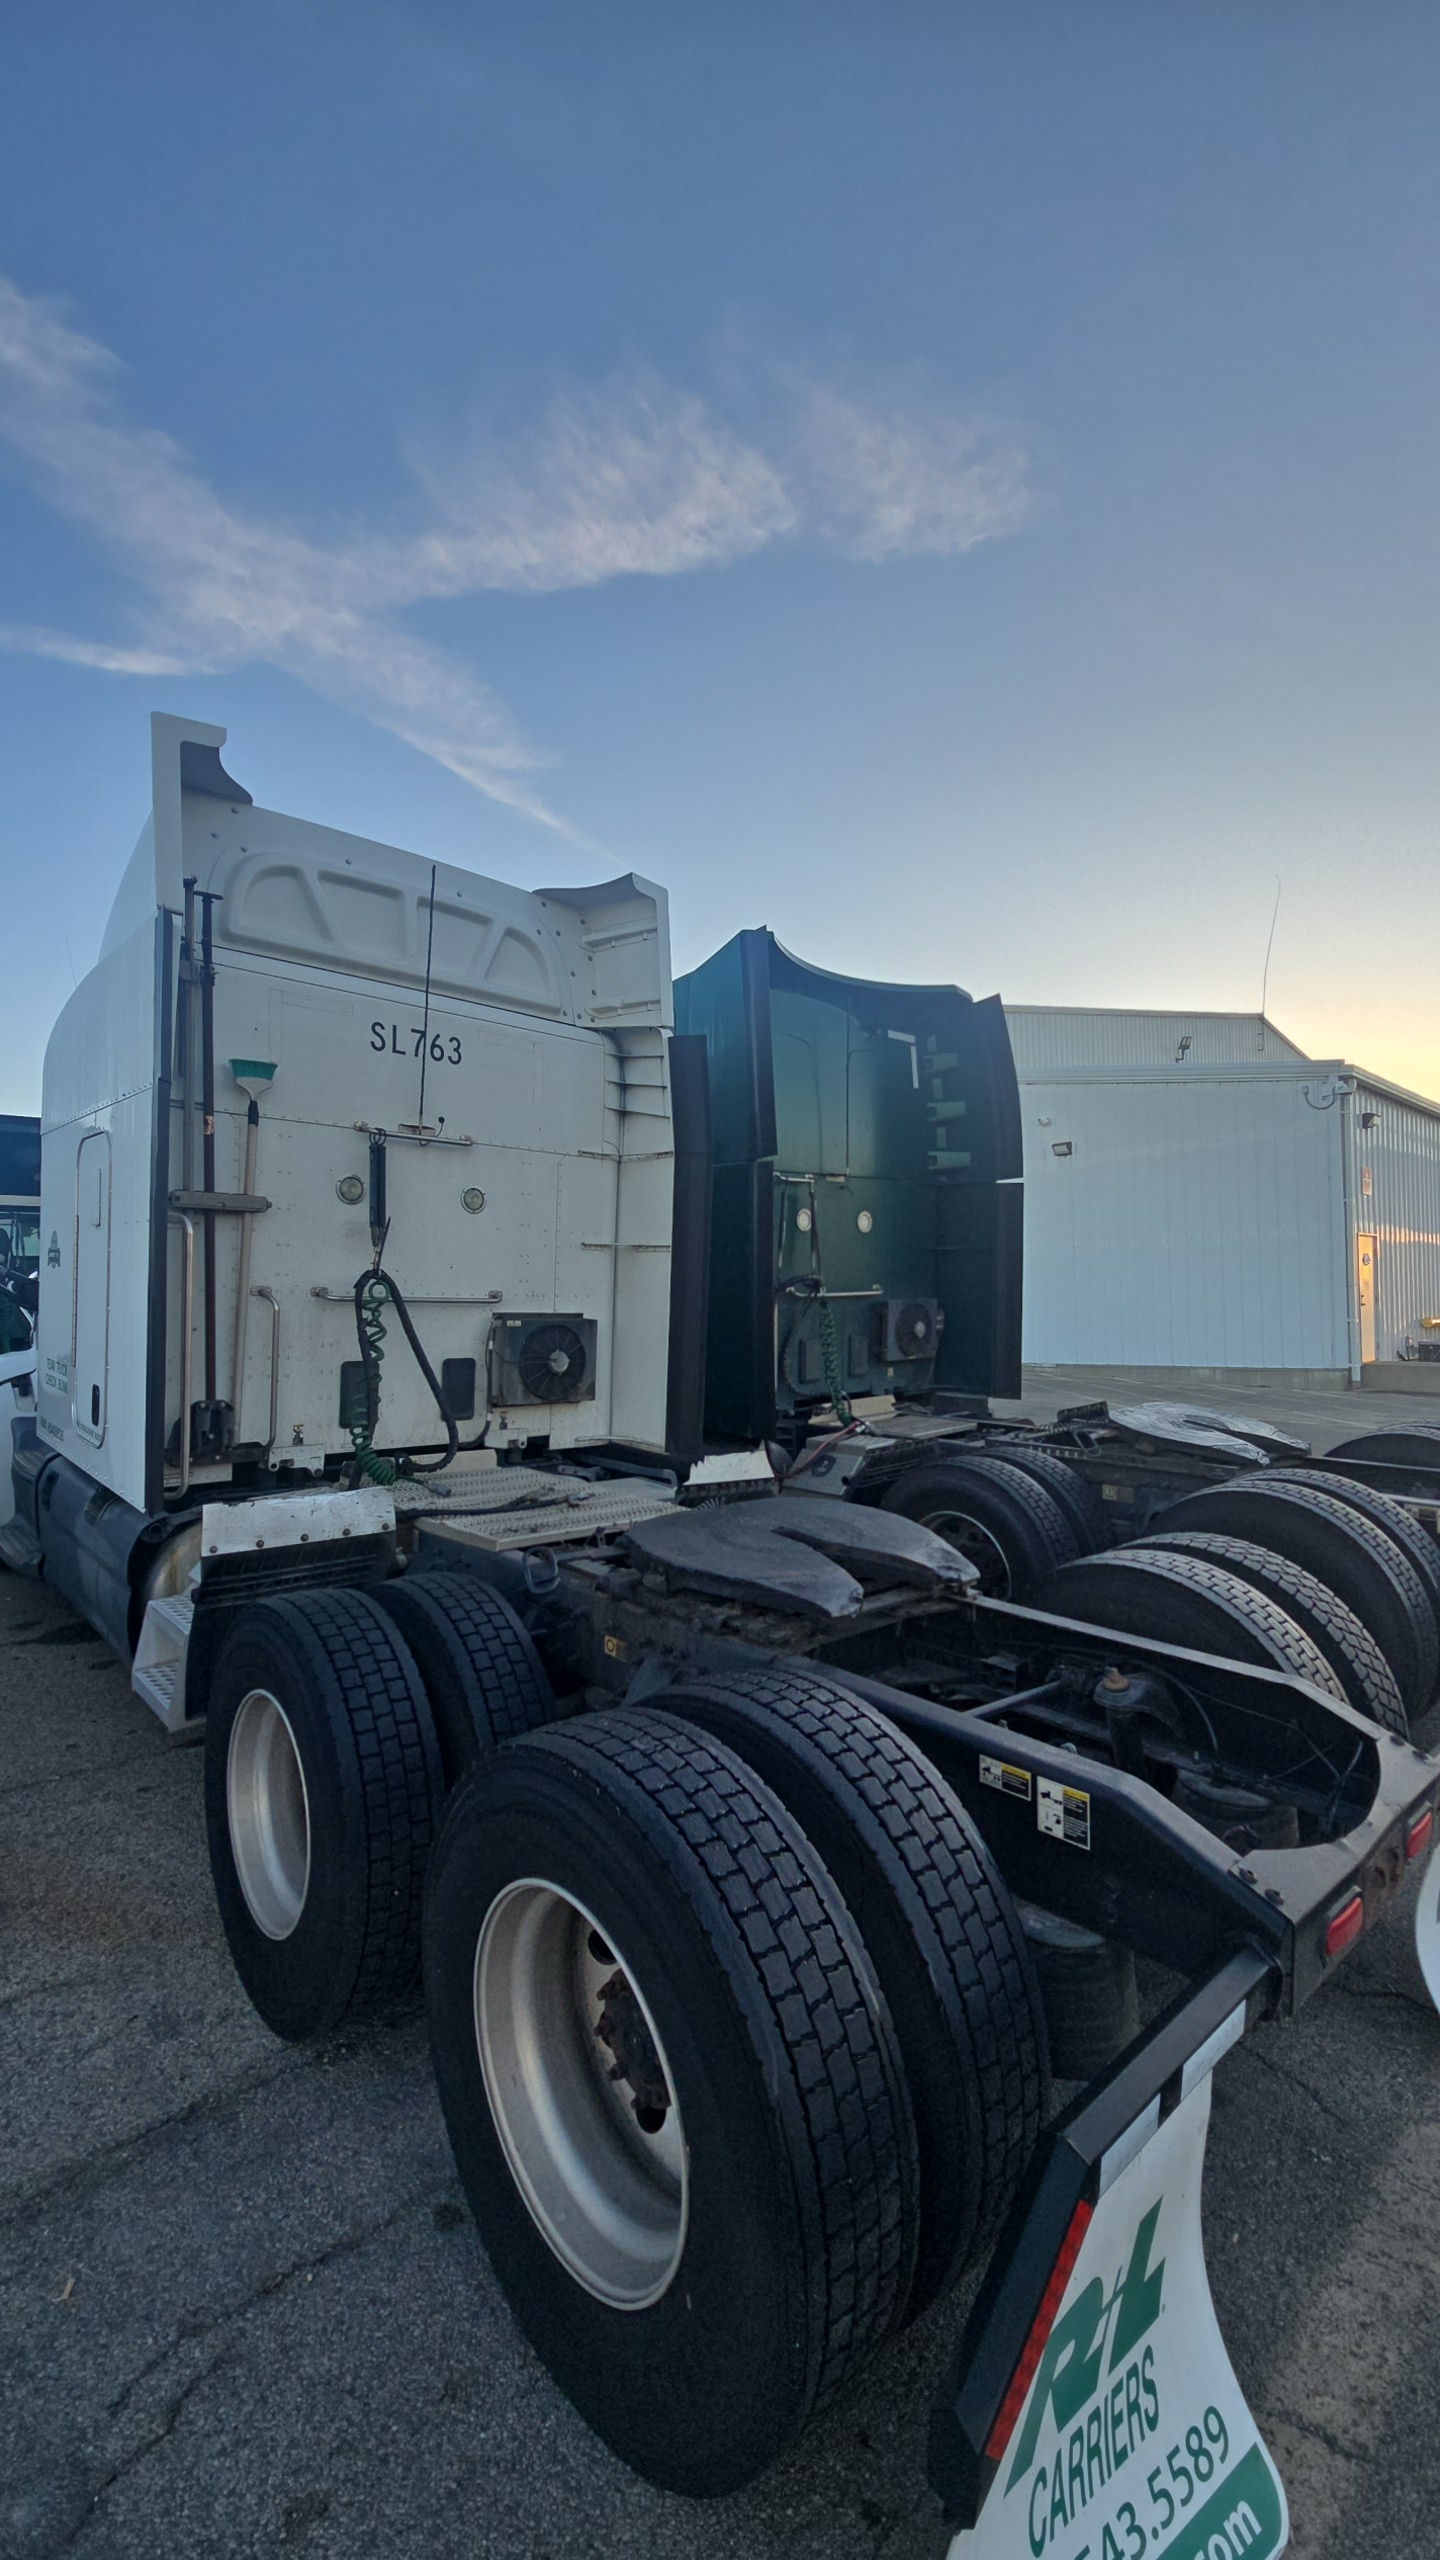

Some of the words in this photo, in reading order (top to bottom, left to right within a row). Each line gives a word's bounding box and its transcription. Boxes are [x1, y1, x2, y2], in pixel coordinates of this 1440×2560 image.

[370, 1021, 462, 1065] SL763
[1028, 2344, 1159, 2559] CARRIERS
[1072, 2405, 1229, 2560] 43.5589
[1193, 2500, 1262, 2560] om
